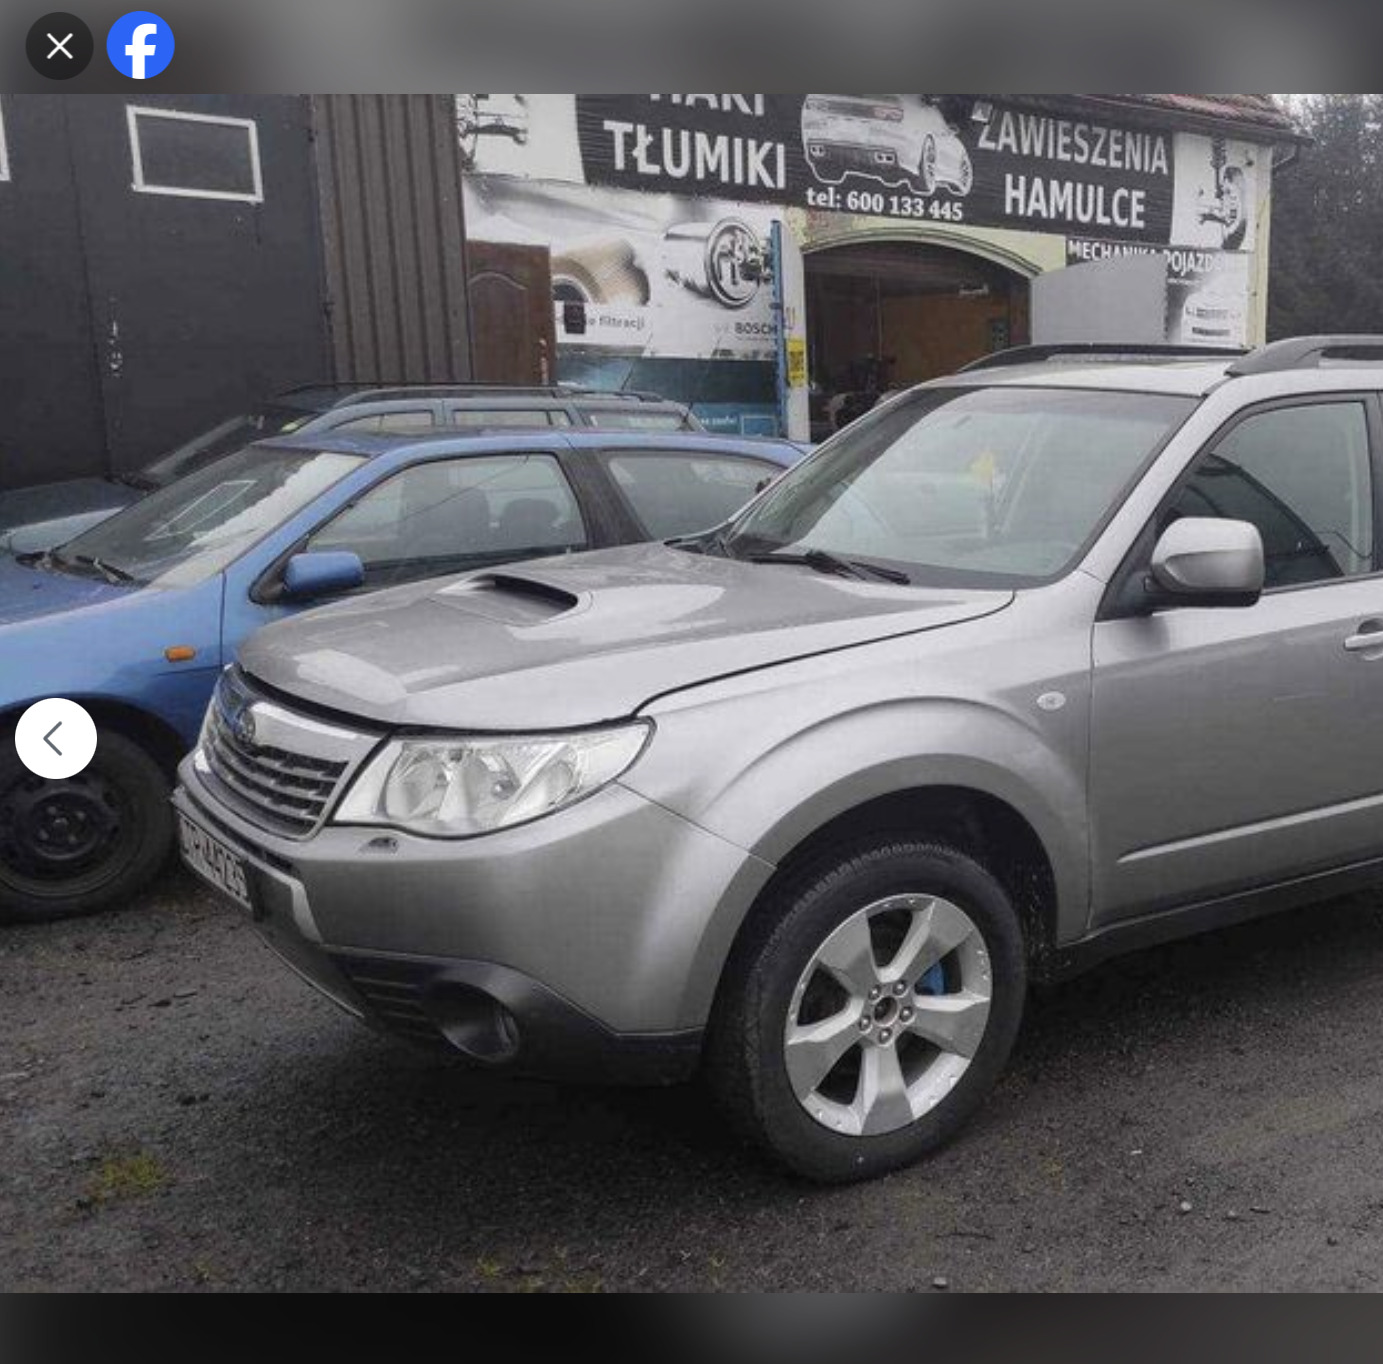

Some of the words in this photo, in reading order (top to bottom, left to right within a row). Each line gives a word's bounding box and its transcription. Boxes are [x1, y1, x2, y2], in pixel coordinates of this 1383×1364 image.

[603, 119, 785, 190] TŁUMIKI
[978, 111, 1168, 176] ZAWIESZENIA
[806, 187, 842, 208] tel:
[847, 191, 884, 213] 600
[890, 196, 924, 217] 133
[929, 200, 963, 221] 445
[1005, 173, 1146, 228] HAMULCE
